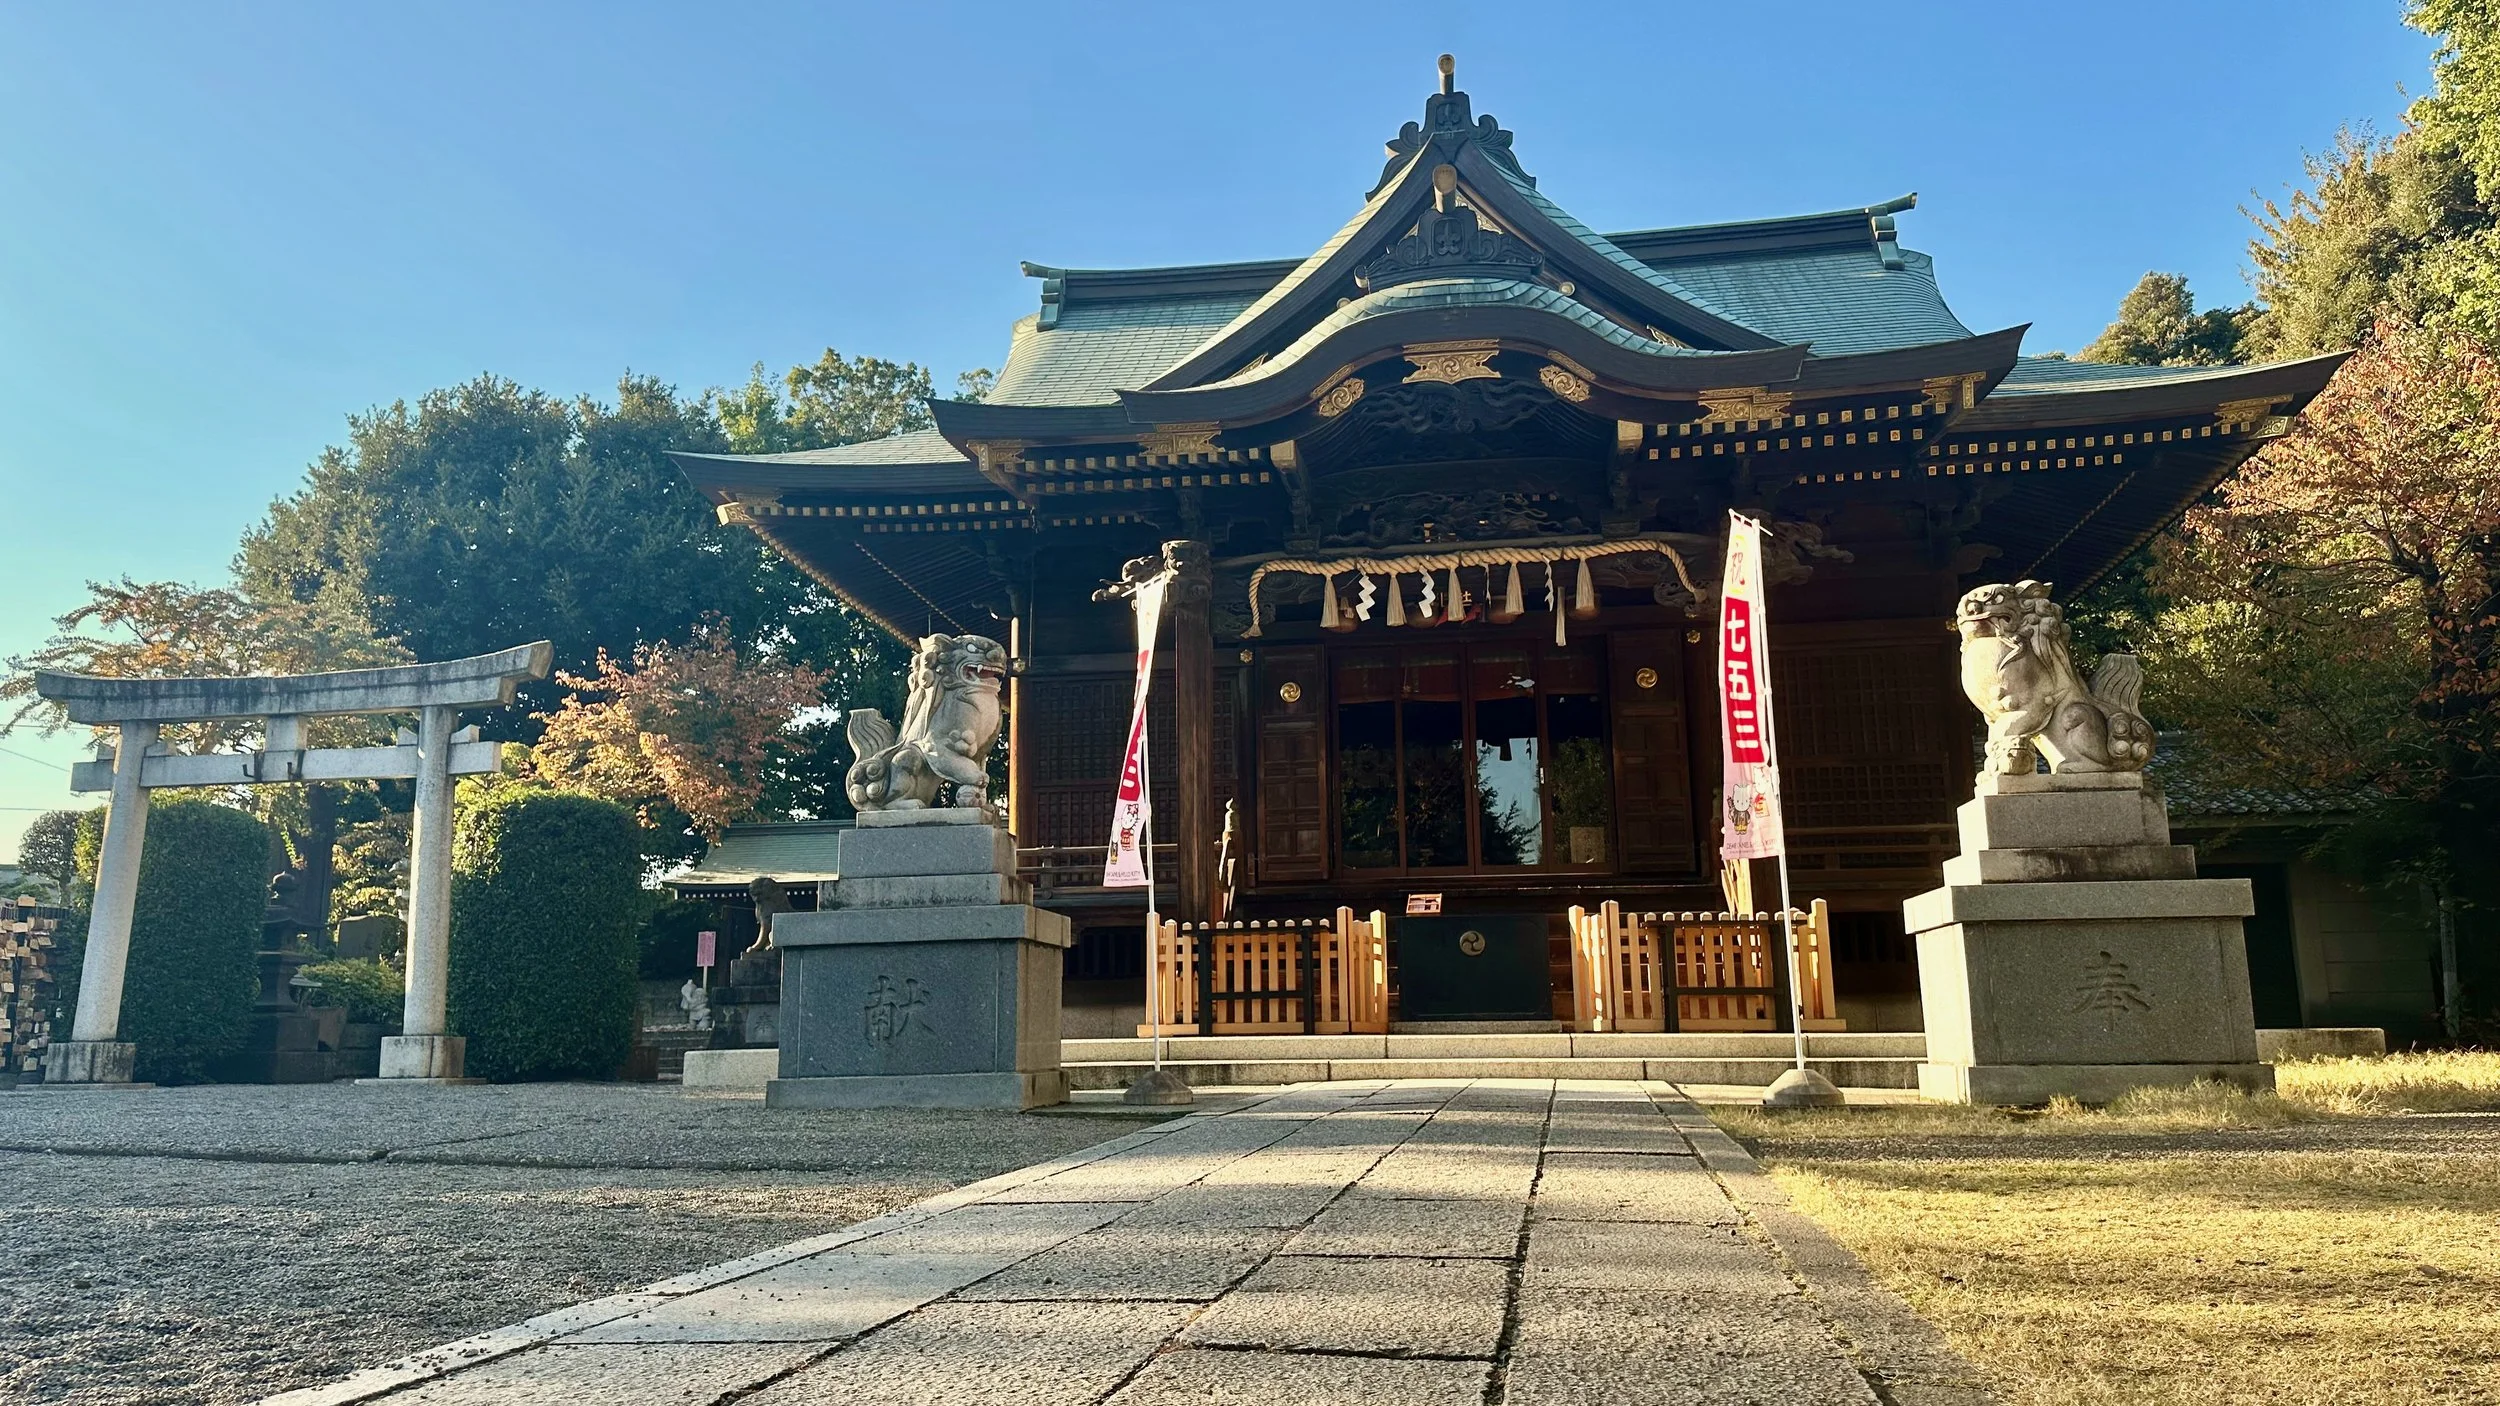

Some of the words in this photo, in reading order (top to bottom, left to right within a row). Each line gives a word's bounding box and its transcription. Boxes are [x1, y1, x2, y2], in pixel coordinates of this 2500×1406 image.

[1726, 608, 1759, 749] 七五三
[864, 974, 939, 1048] 献
[2071, 950, 2151, 1032] 奉
